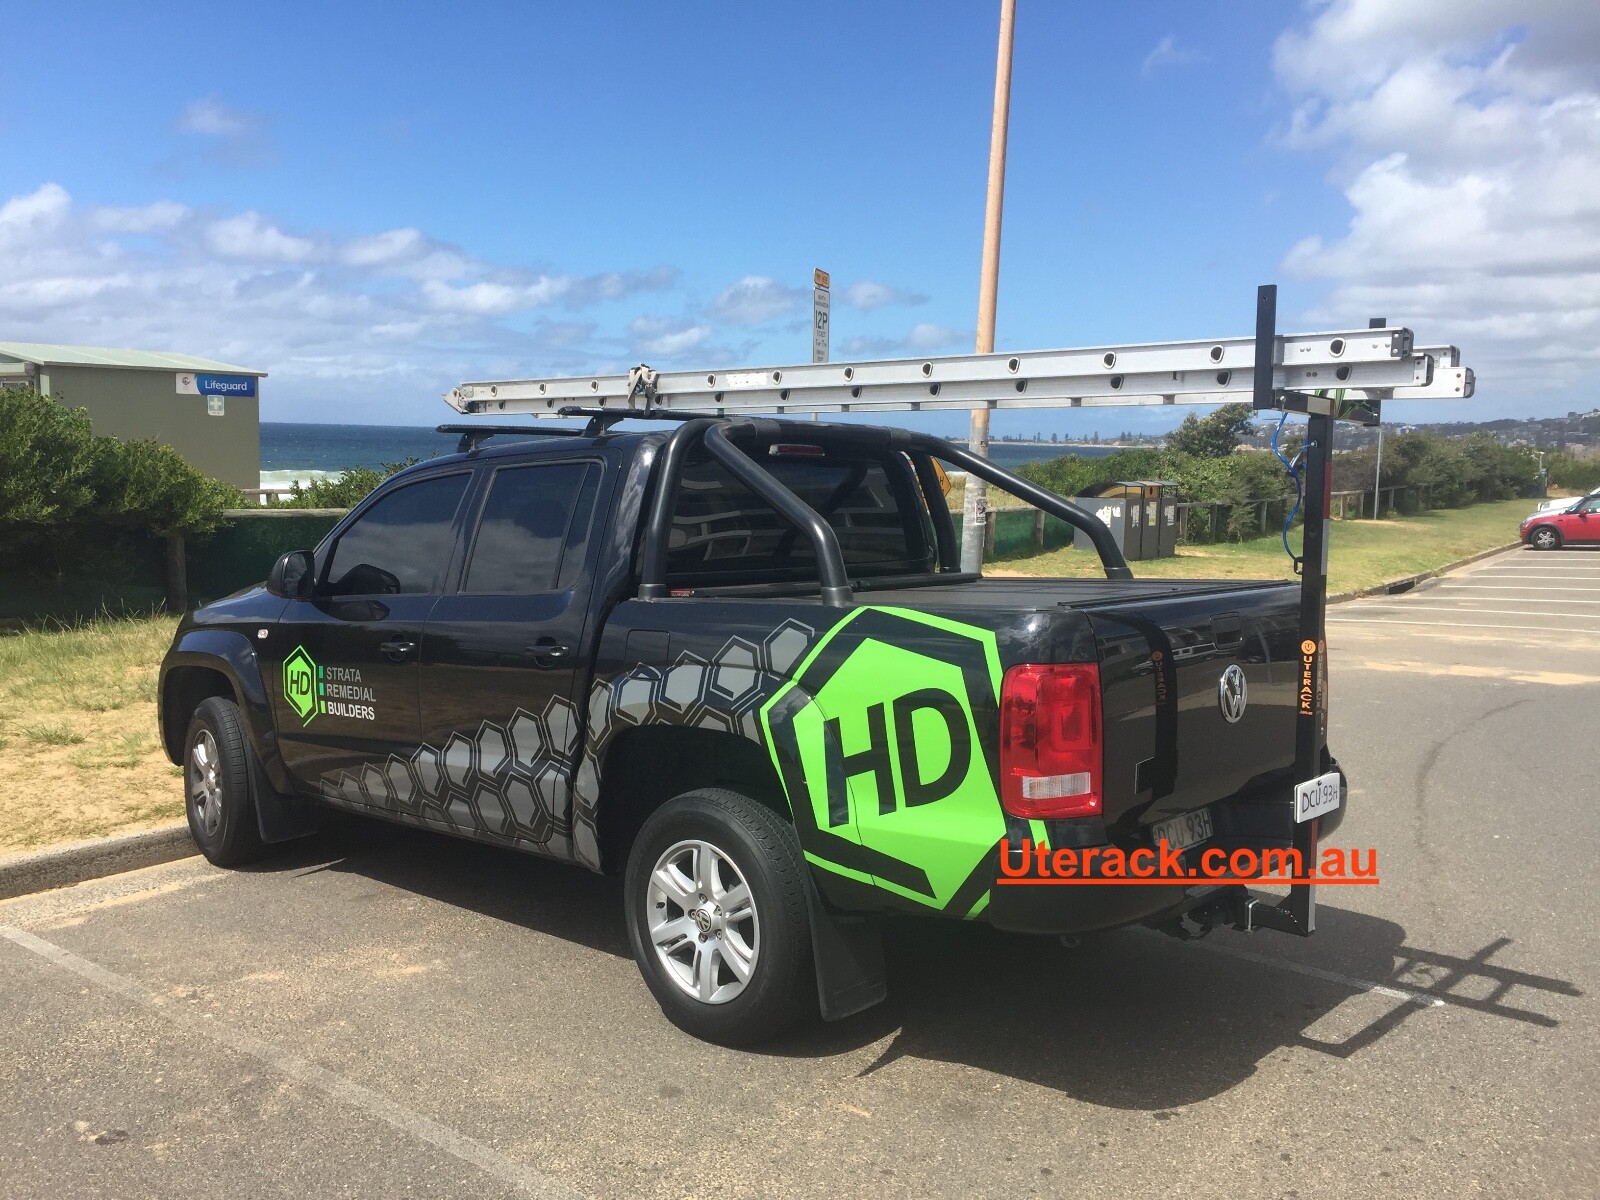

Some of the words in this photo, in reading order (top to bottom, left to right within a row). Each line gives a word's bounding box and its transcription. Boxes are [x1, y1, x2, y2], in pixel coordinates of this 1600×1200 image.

[204, 379, 248, 392] Lifeguard
[290, 669, 311, 696] HD
[326, 666, 362, 683] STRATA
[1301, 655, 1313, 709] UTERACK
[326, 683, 377, 702] REMEDIAL
[327, 701, 376, 721] BUILDERS
[823, 687, 972, 829] HD
